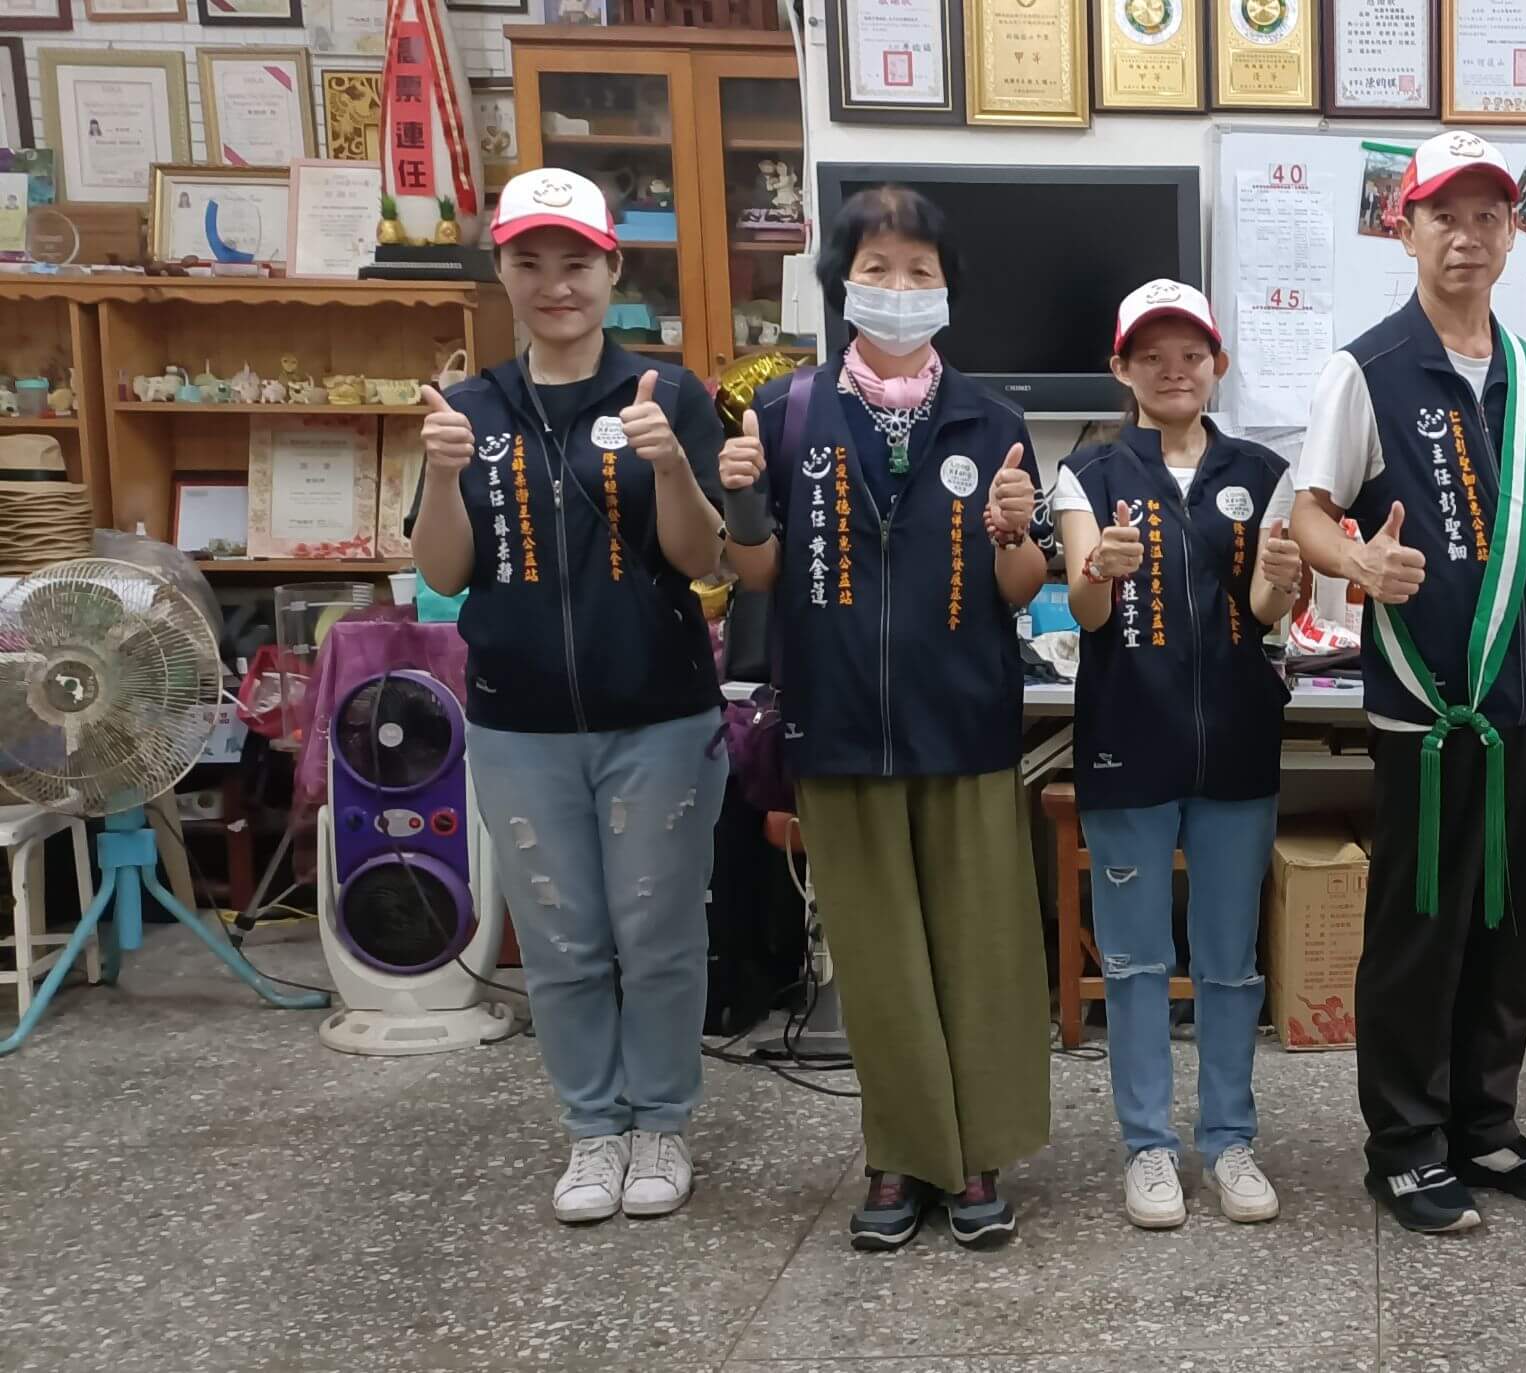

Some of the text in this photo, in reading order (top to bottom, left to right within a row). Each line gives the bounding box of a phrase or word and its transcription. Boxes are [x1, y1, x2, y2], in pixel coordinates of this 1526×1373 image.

[1272, 164, 1303, 184] 40
[1270, 288, 1300, 308] 45
[1431, 443, 1452, 486] 主任
[488, 466, 505, 508] 主任
[810, 484, 827, 528] 主任
